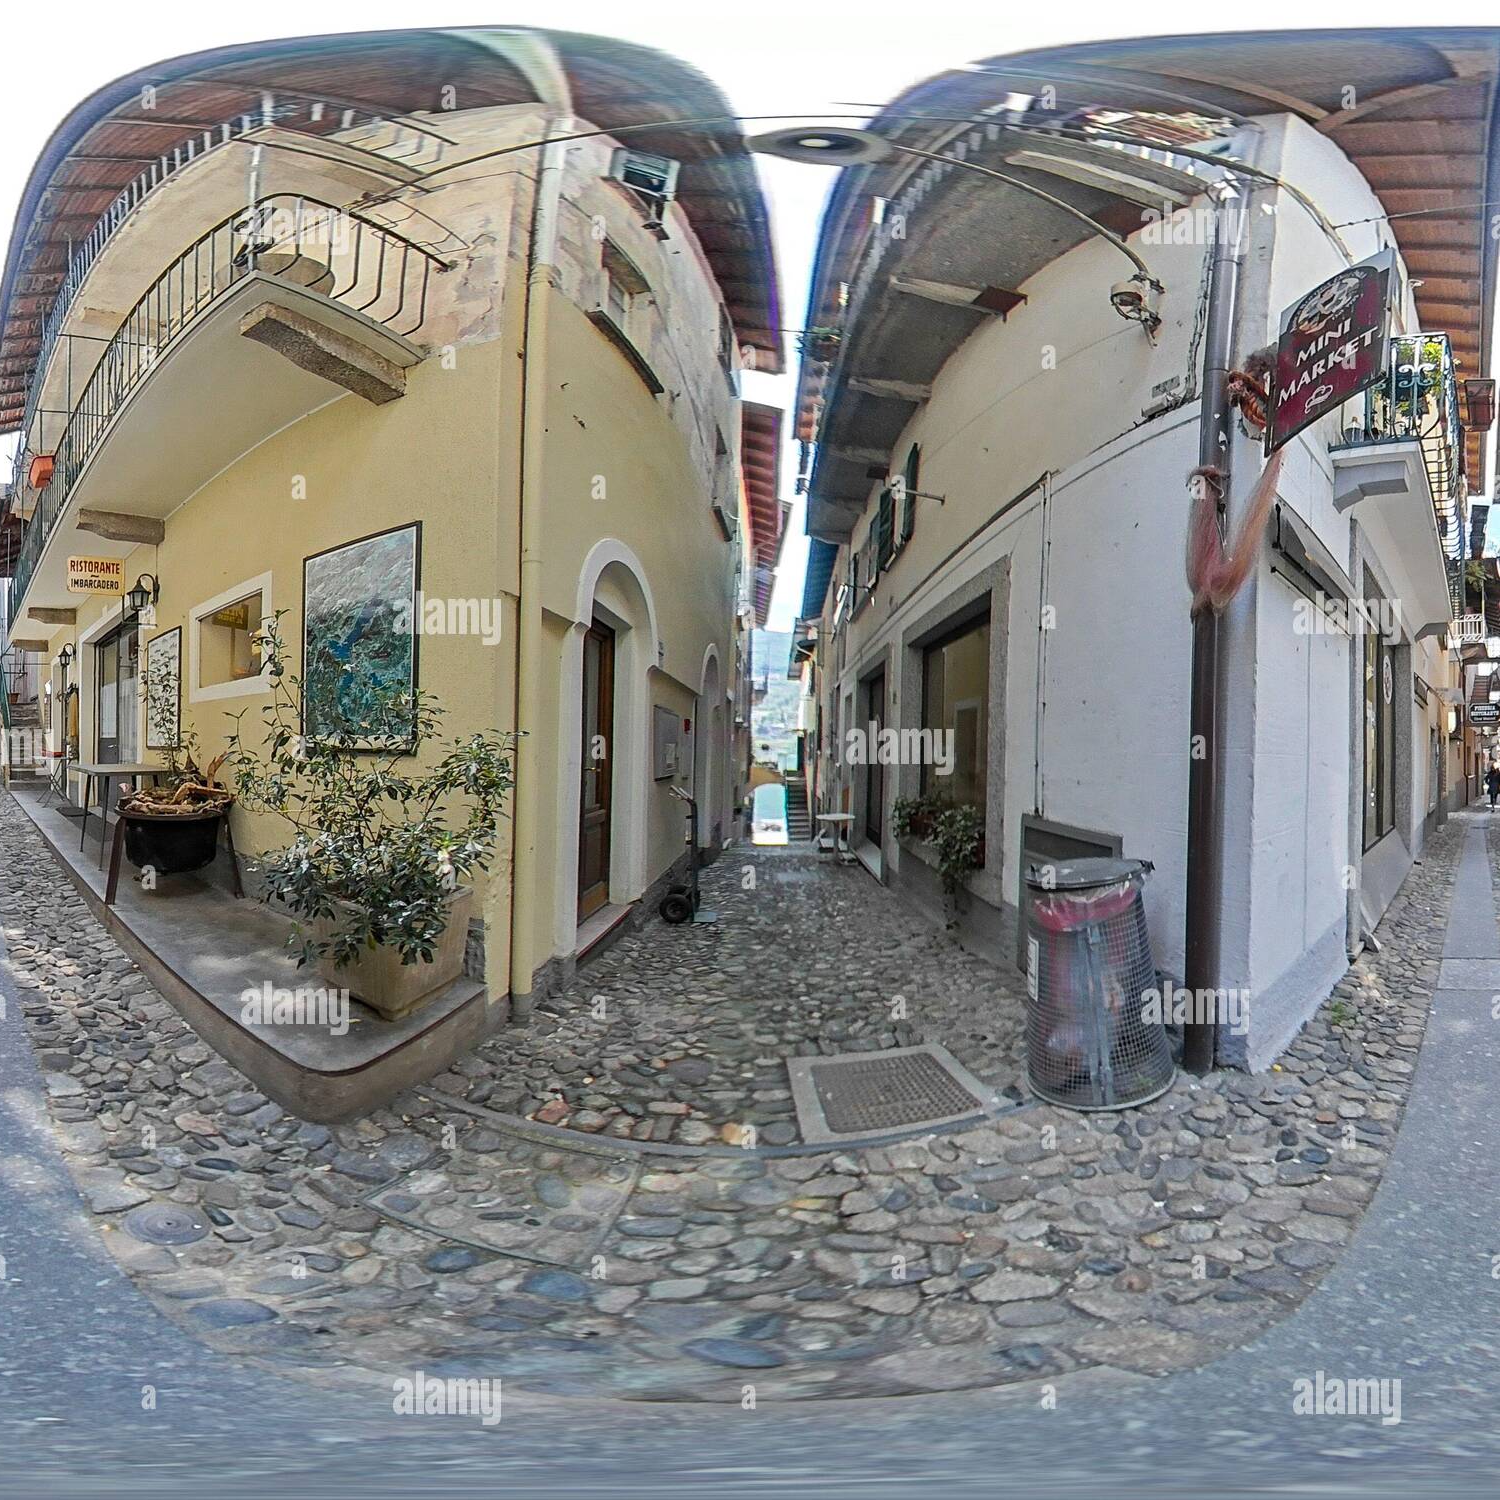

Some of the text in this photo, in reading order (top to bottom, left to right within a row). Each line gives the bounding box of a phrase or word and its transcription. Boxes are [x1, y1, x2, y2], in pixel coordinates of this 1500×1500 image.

[1296, 318, 1351, 367] MINI
[1277, 326, 1379, 407] MARKET
[70, 559, 120, 574] RISTORANTE
[71, 578, 119, 590] IMBARCADERO
